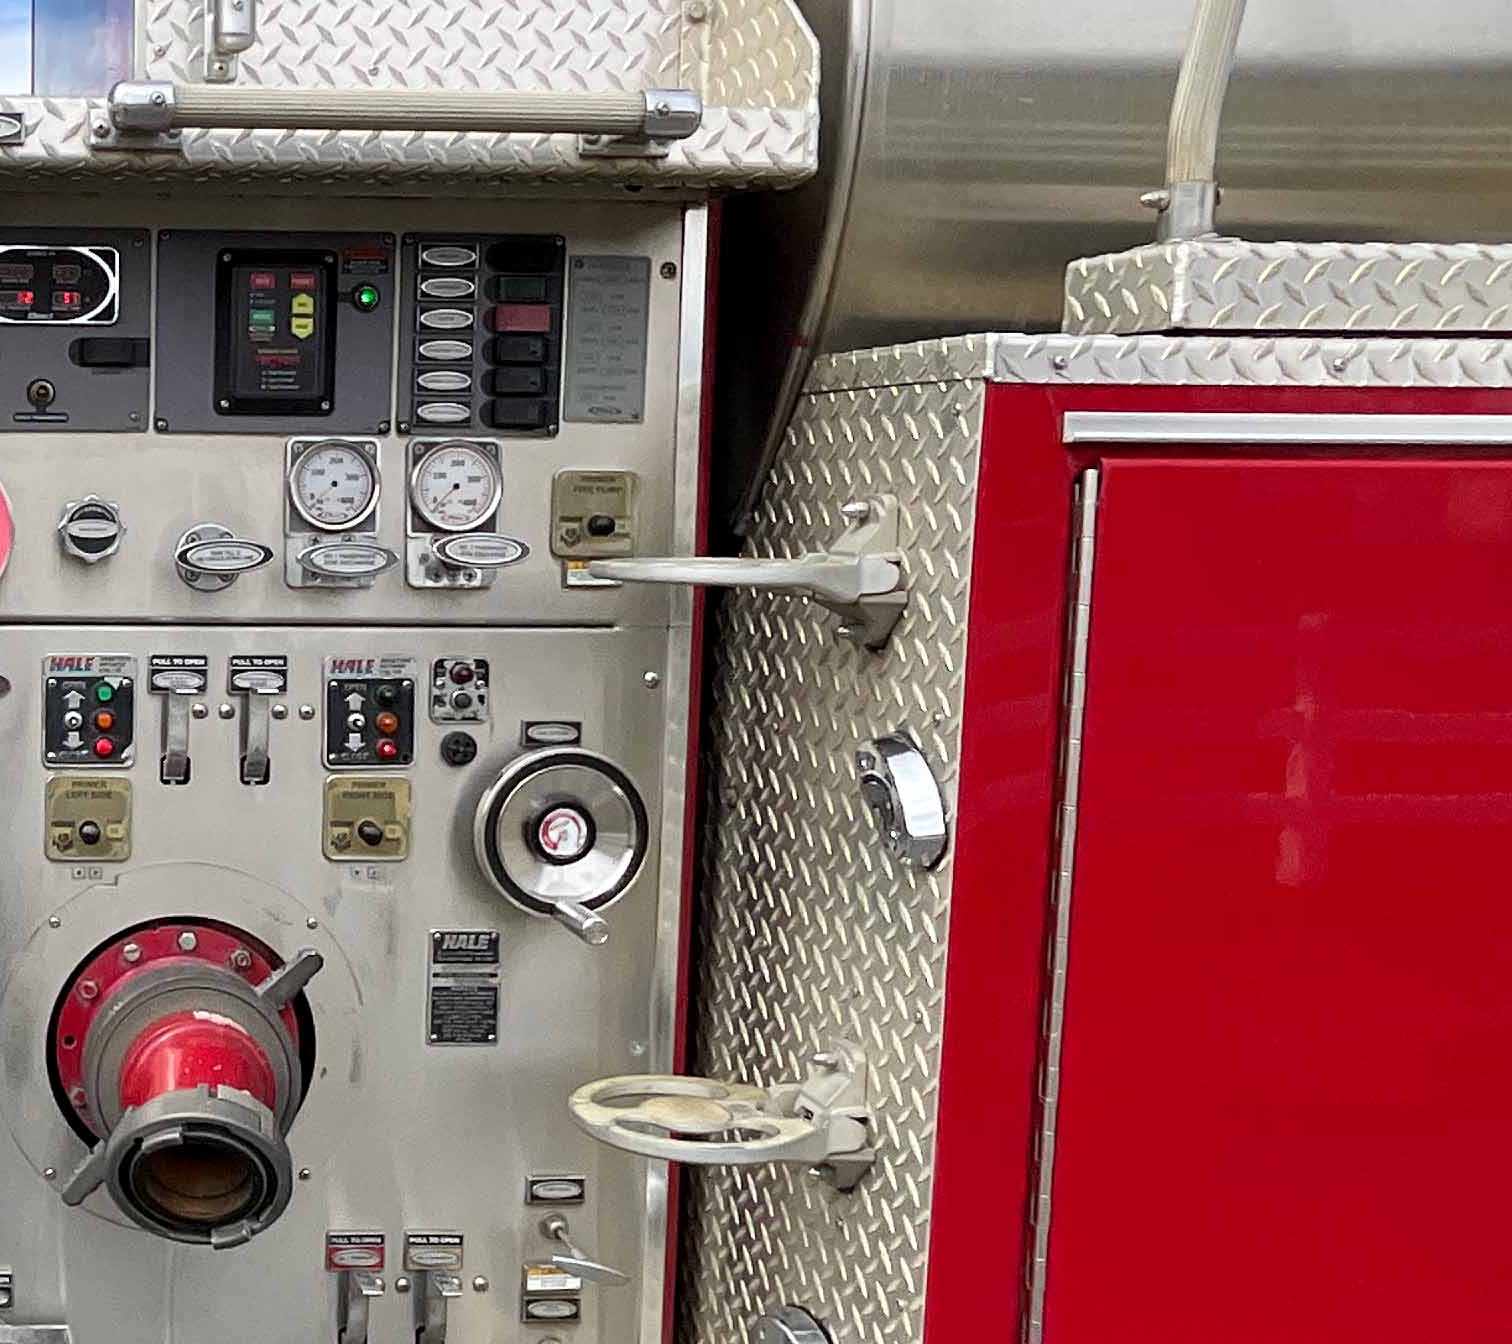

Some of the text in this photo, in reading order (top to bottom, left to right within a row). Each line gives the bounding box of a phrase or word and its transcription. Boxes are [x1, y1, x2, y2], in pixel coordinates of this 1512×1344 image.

[48, 657, 94, 671] HALE
[152, 658, 171, 666] PULL
[185, 658, 205, 666] OPEN
[233, 658, 250, 666] PULL
[265, 658, 284, 666] OPEN
[330, 659, 375, 674] HALE
[442, 935, 489, 949] HALE
